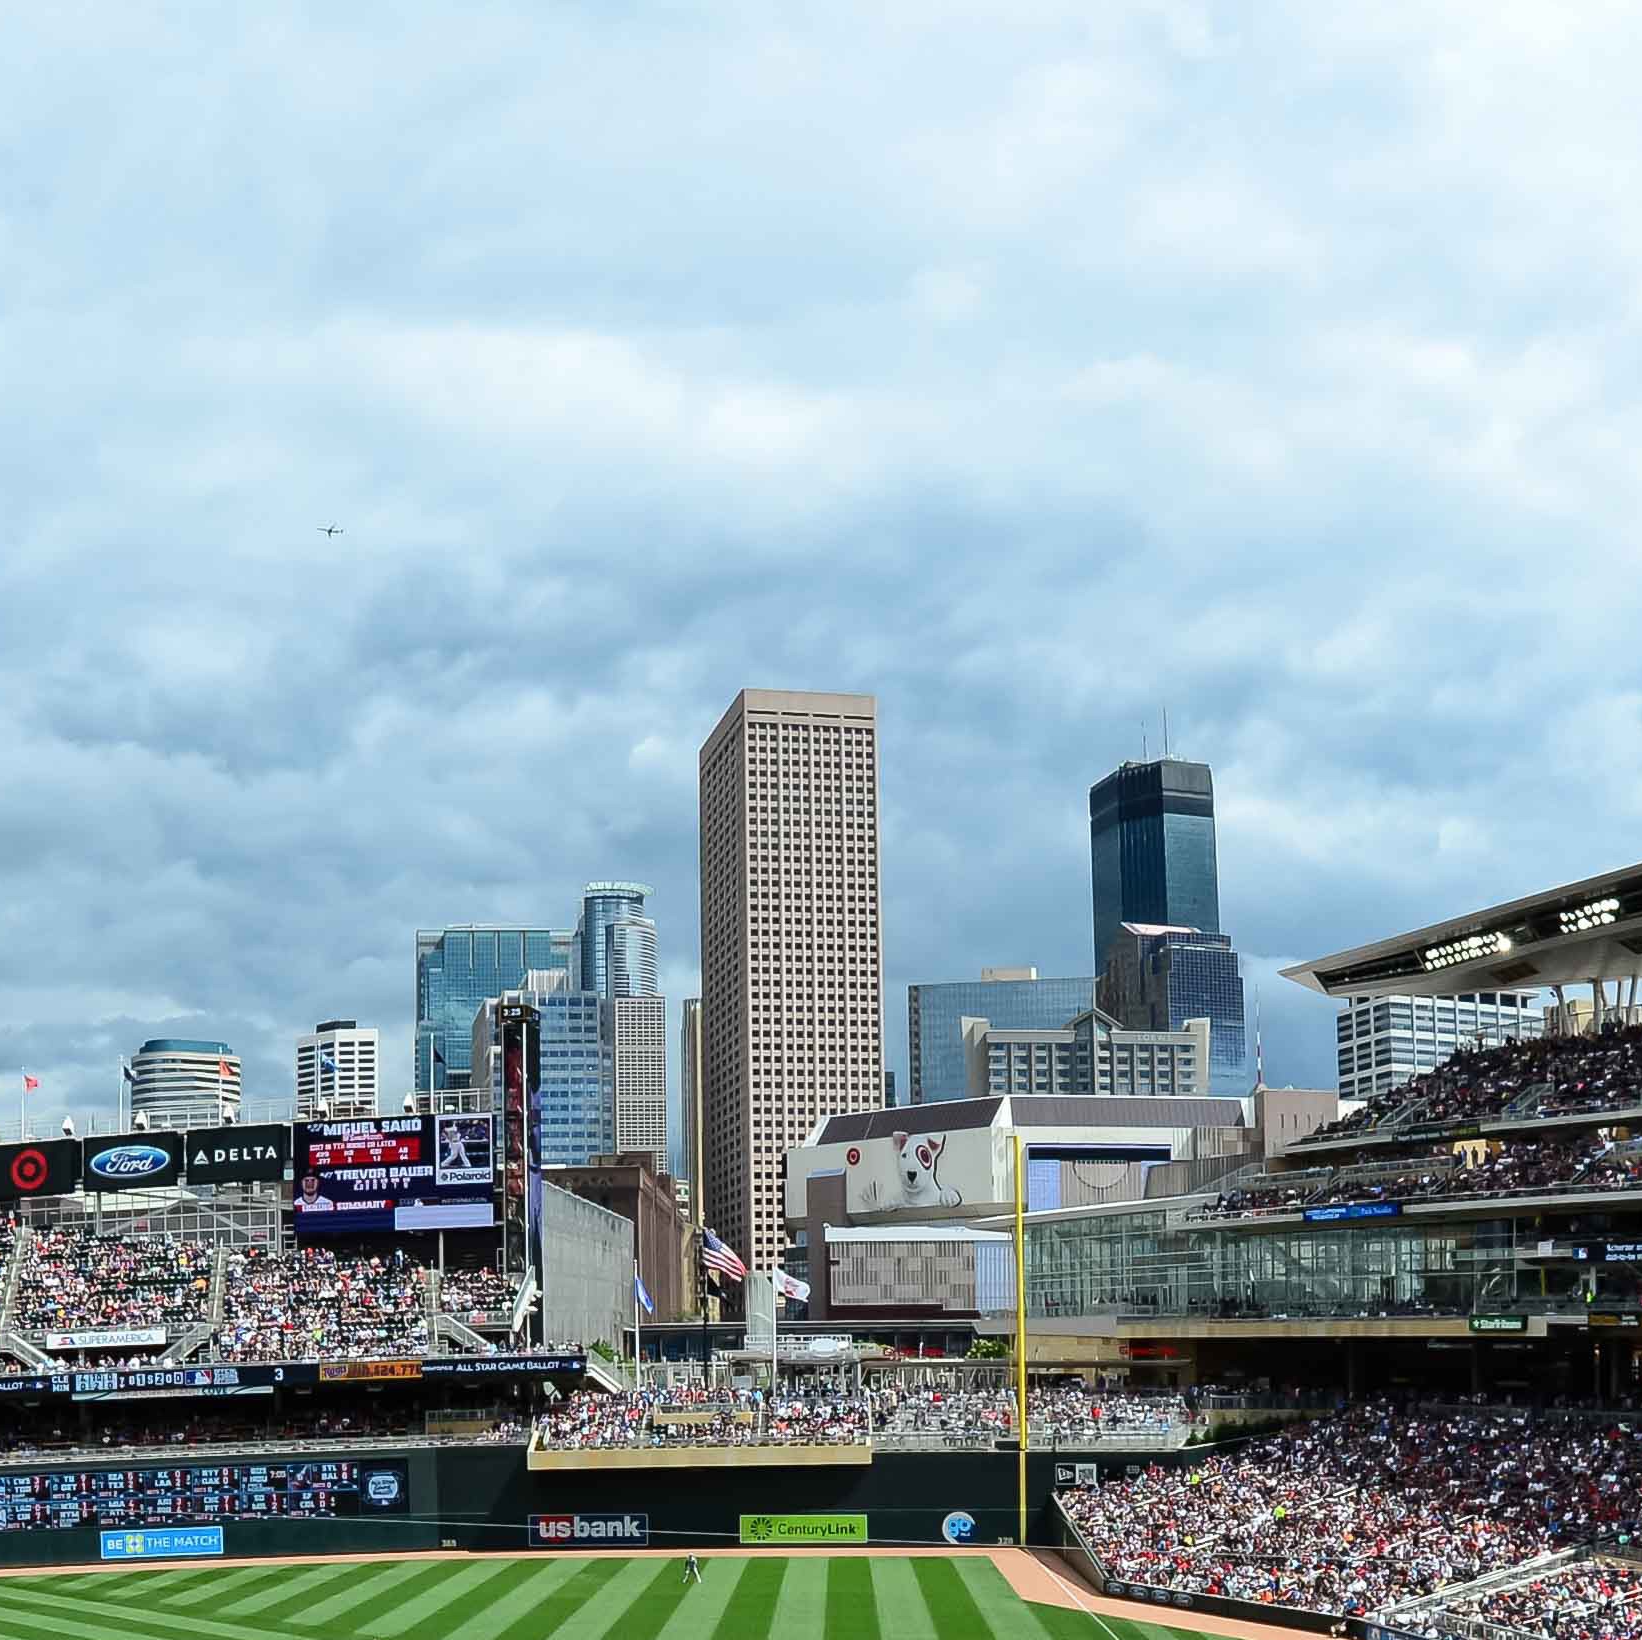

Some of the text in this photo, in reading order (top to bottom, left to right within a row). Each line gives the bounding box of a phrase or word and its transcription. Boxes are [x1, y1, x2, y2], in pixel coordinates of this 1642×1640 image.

[323, 1122, 377, 1136] MIGUEL
[376, 1140, 397, 1148] LATER
[214, 1145, 277, 1163] DELTA
[105, 1150, 154, 1173] Ford
[334, 1165, 434, 1182] TREVOR BAUER
[449, 1169, 492, 1182] Polaroid
[336, 1200, 387, 1211] SUMMARY
[78, 1335, 155, 1346] SUPERAMERICA
[456, 1362, 473, 1372] ALL
[474, 1361, 497, 1371] STAR
[497, 1360, 526, 1371] GAME
[526, 1359, 561, 1371] BALLOT
[51, 1376, 69, 1384] CLE
[274, 1368, 284, 1381] 3
[108, 1480, 125, 1489] TEX
[154, 1478, 172, 1487] LAA
[777, 1521, 857, 1537] CenturyLink
[107, 1535, 220, 1550] BE THE MATCH
